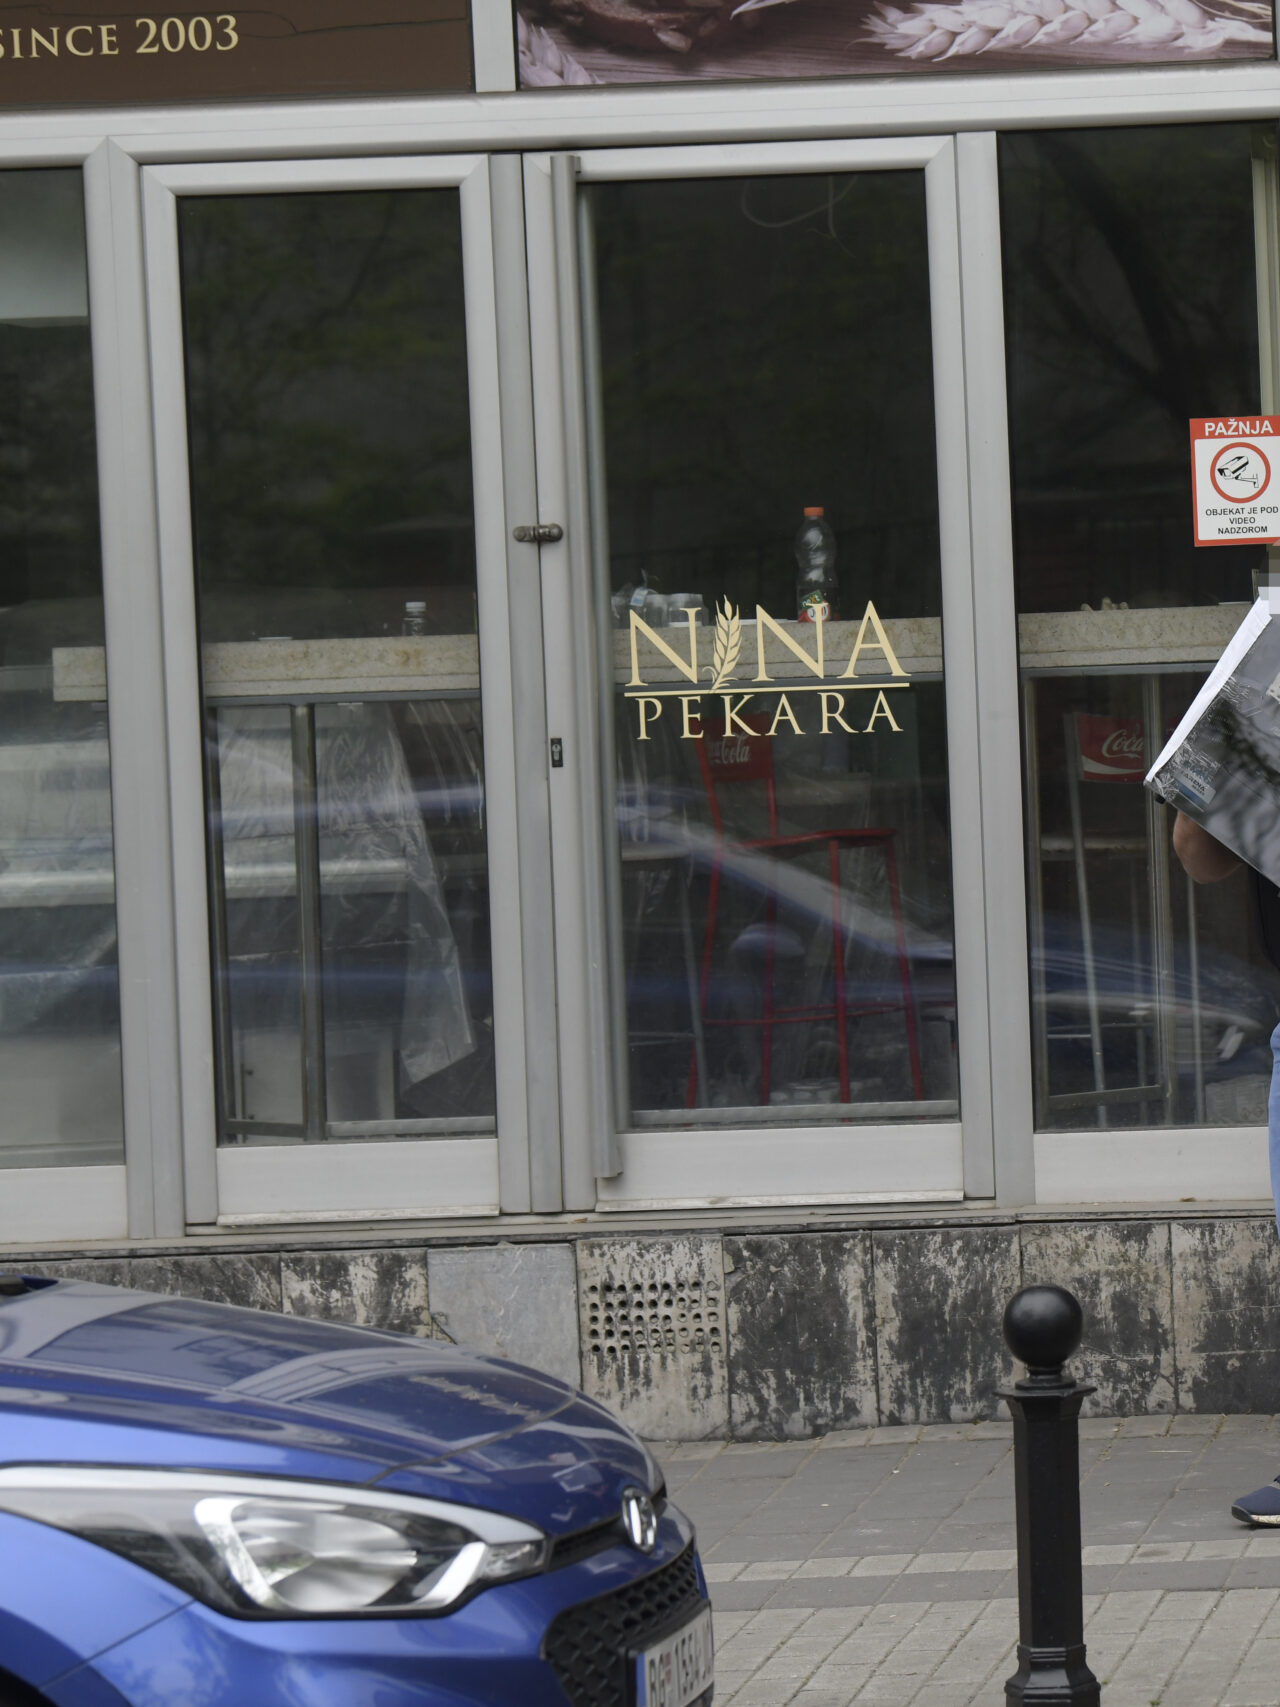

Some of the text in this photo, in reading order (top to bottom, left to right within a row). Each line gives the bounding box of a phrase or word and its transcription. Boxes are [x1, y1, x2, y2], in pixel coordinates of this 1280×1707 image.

[135, 14, 240, 54] 2003
[1204, 418, 1274, 437] PAŽNJA
[1205, 506, 1279, 516] OBJEKAT JE POD
[1229, 516, 1256, 525] VIDEO
[1217, 525, 1268, 534] NADZOROM
[635, 690, 904, 741] PEKARA
